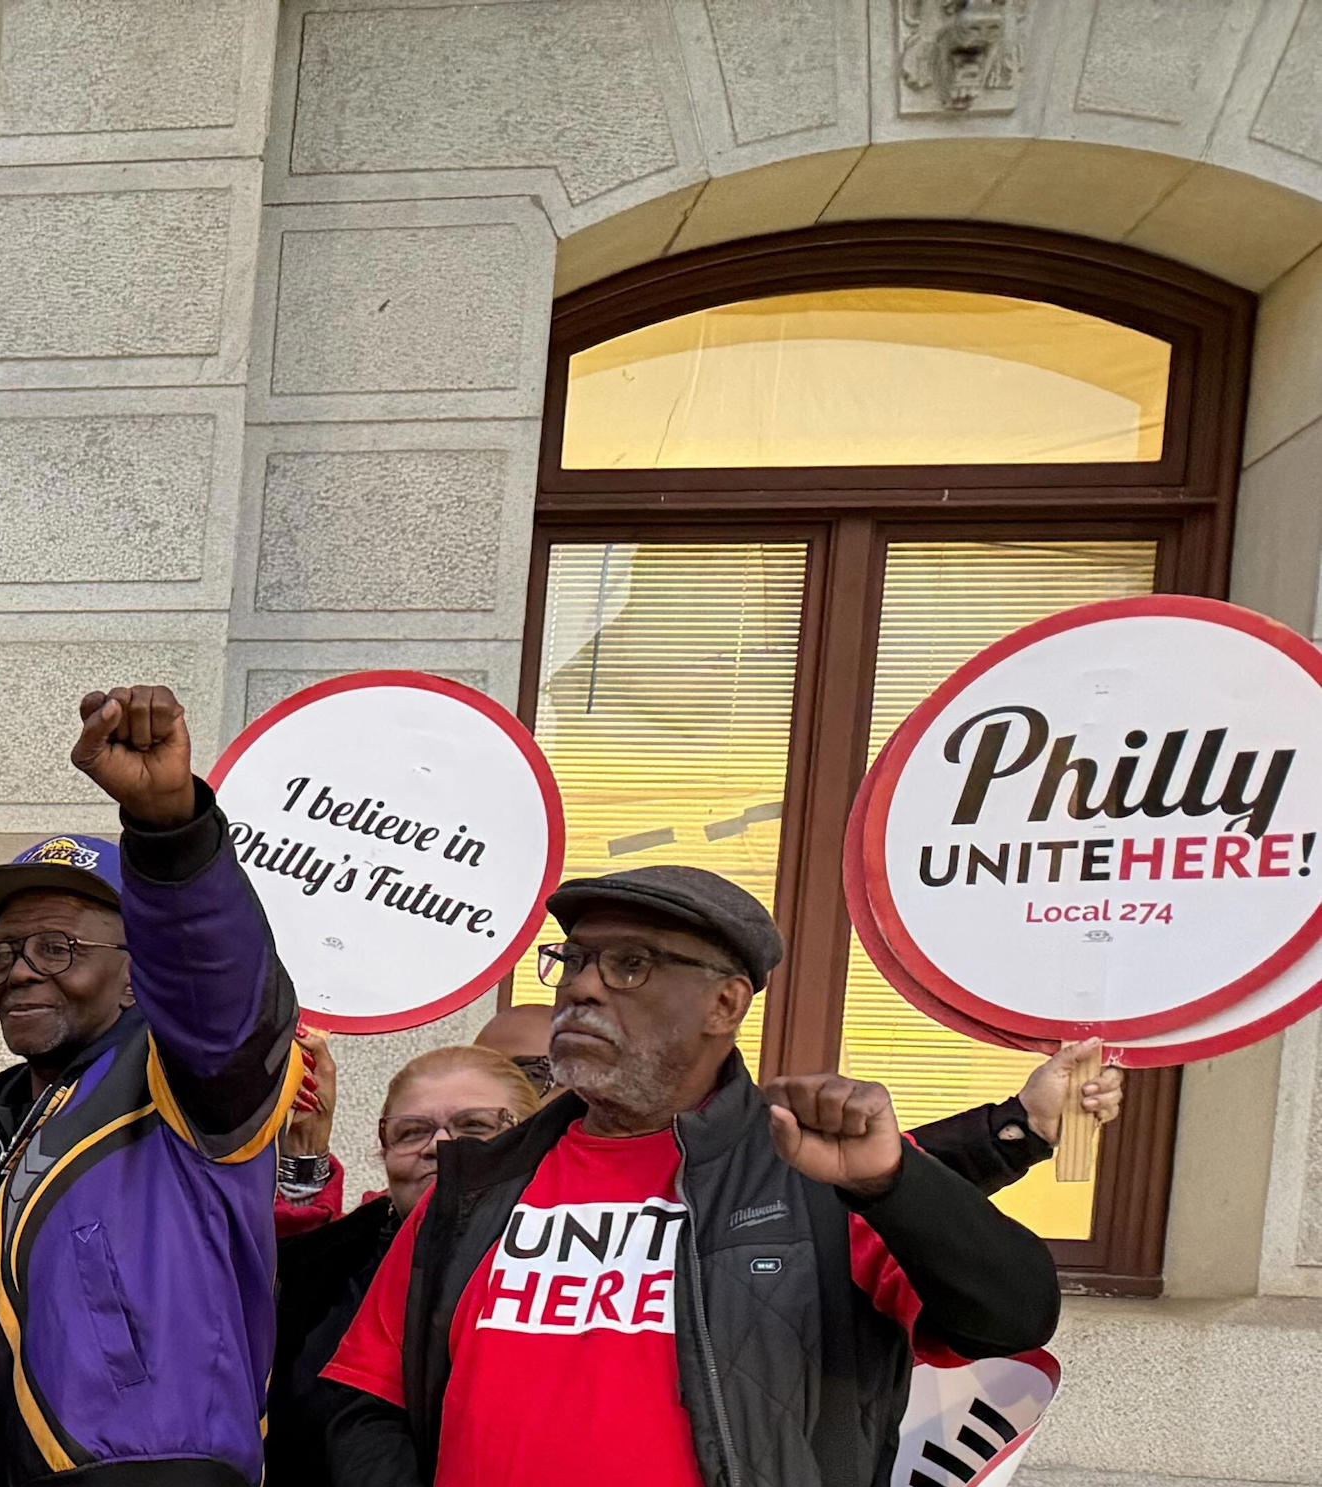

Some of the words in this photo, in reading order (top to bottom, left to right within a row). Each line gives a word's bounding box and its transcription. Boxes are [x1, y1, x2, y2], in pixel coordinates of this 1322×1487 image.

[943, 705, 1297, 841] Philly
[282, 777, 311, 812] I
[307, 785, 440, 851] believe
[443, 825, 486, 867] in
[227, 821, 359, 896] Philly’s
[365, 865, 496, 938] Future.
[918, 832, 1318, 887] UNITEHERE!
[1026, 899, 1111, 923] Local
[1119, 903, 1174, 925] 274
[480, 1269, 675, 1326] HERE
